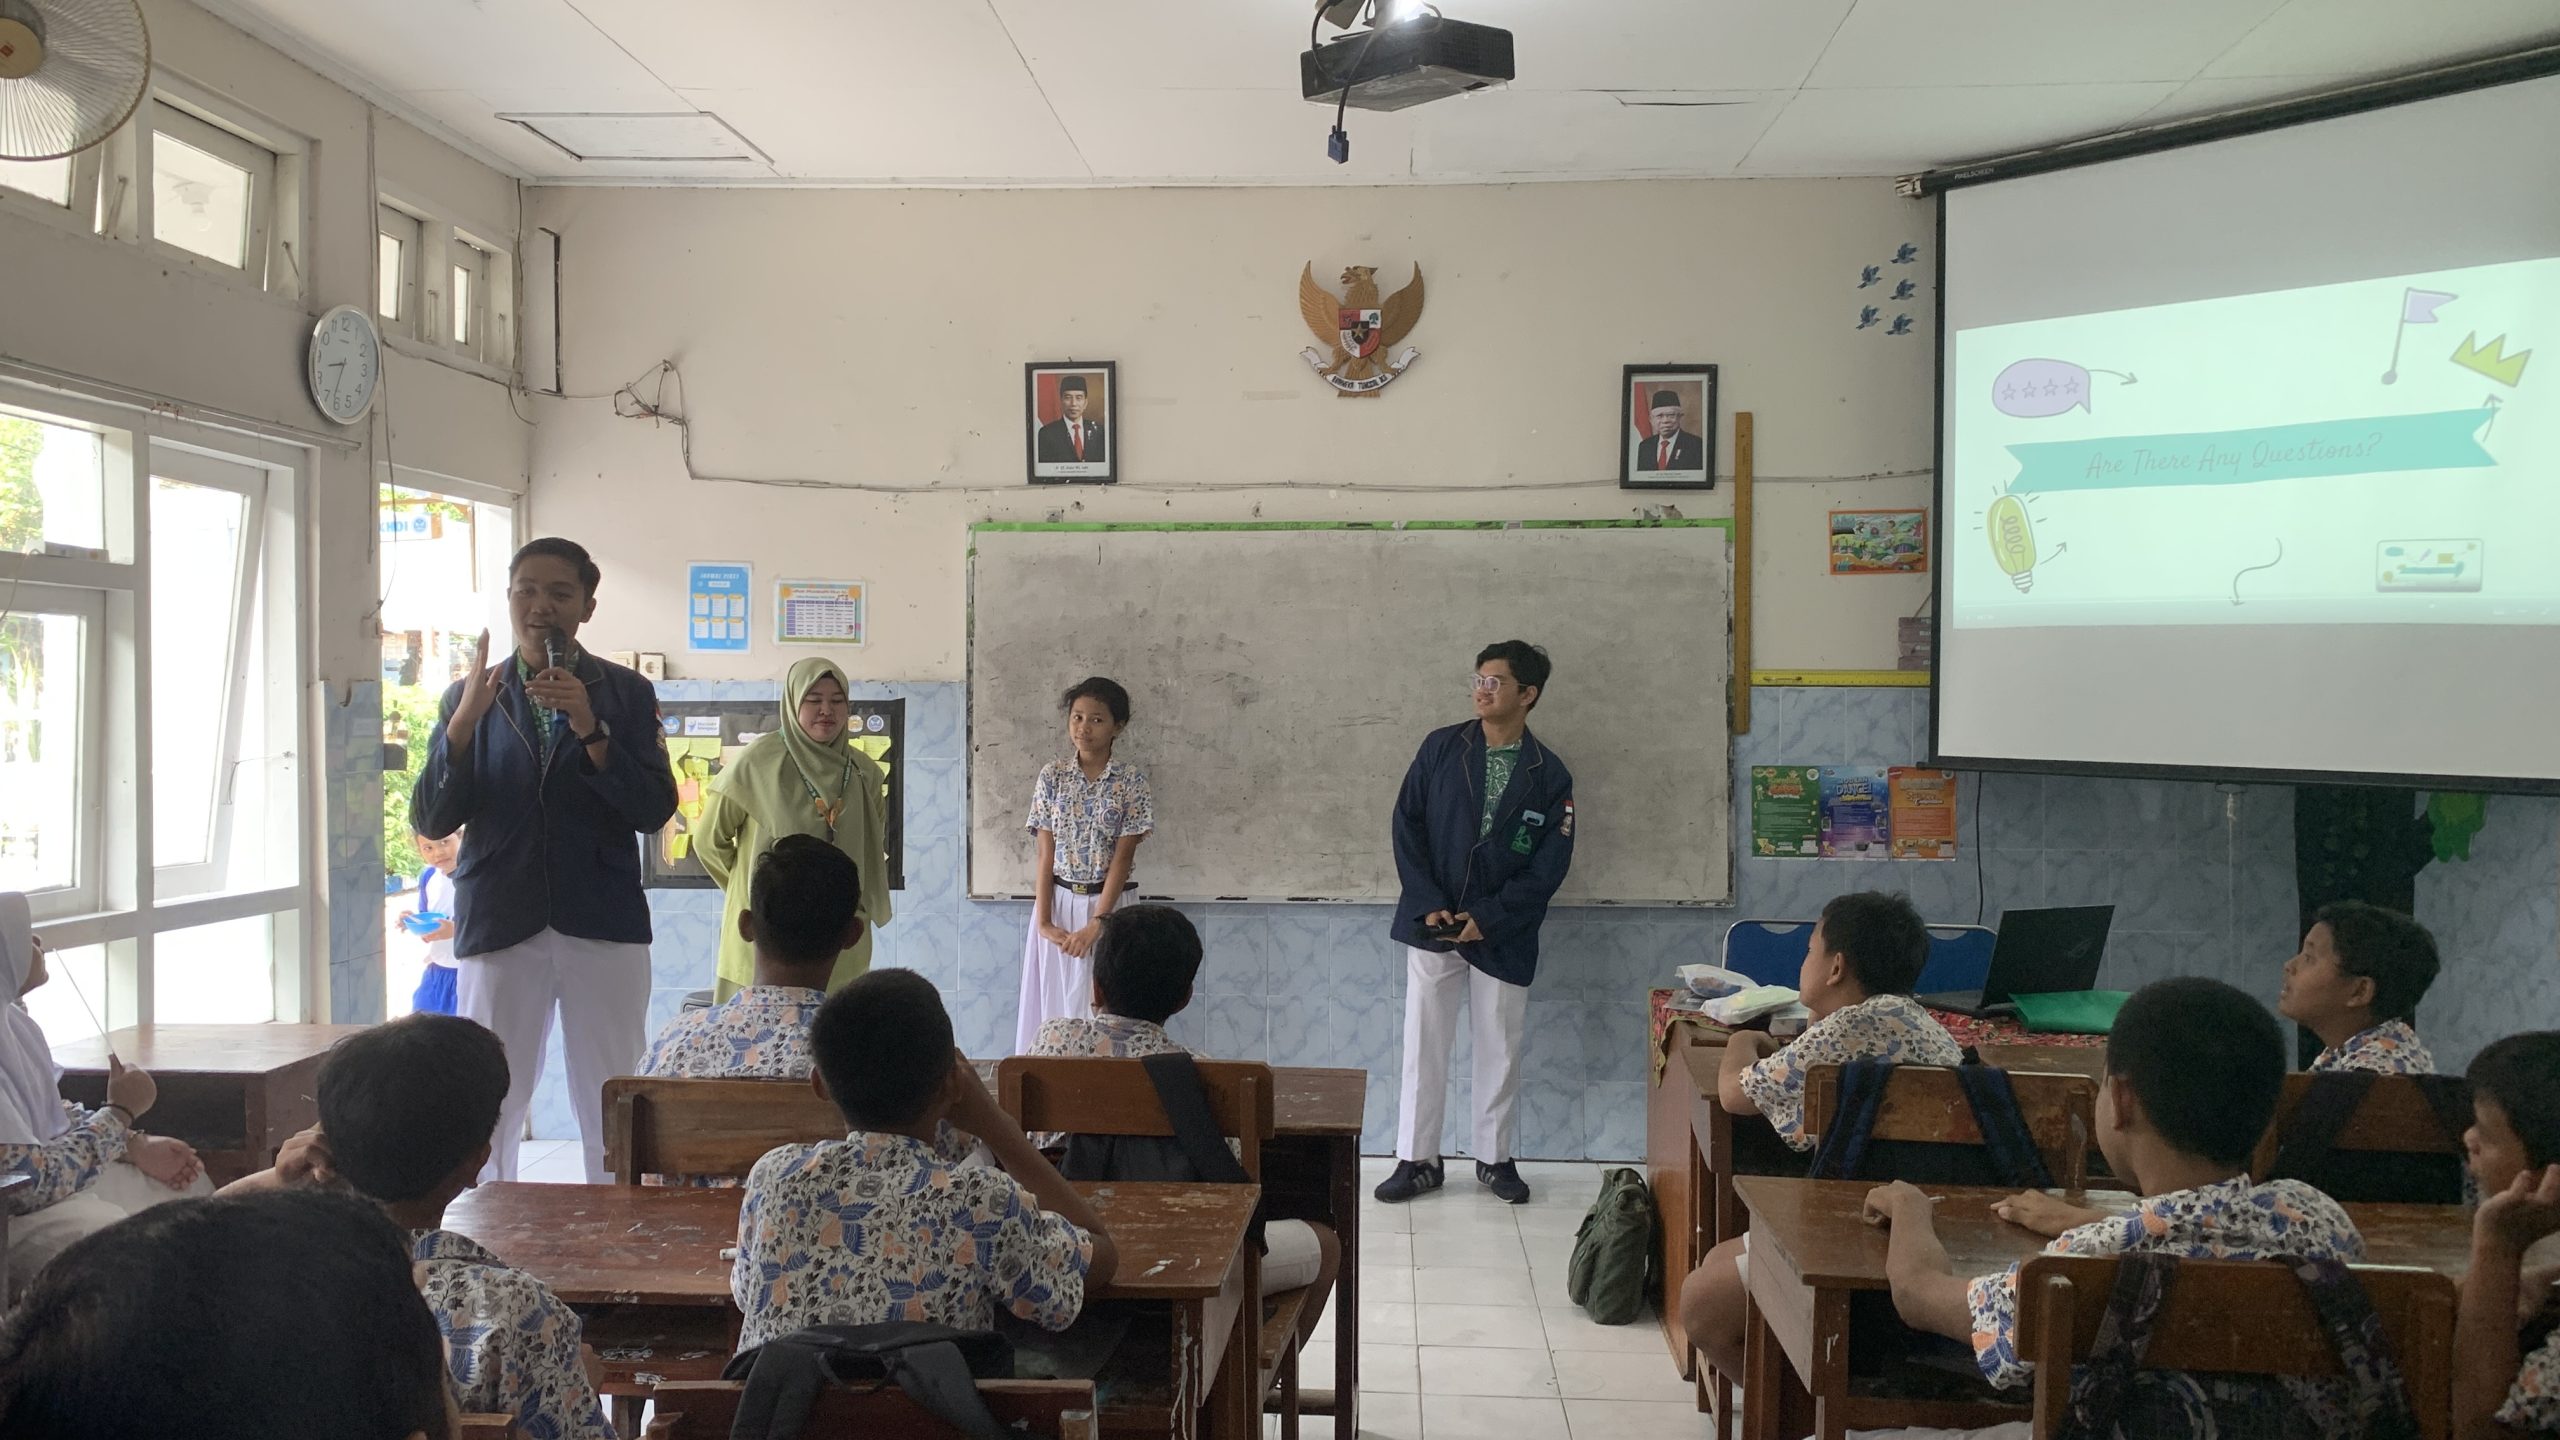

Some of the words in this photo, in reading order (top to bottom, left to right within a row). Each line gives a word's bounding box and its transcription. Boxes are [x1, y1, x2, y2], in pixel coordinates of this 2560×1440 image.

[331, 319, 338, 333] 11
[341, 317, 351, 332] 12
[359, 343, 368, 358] 2
[360, 363, 368, 378] 3
[323, 388, 331, 402] 7
[355, 383, 362, 396] 4
[333, 396, 341, 411] 6
[344, 394, 352, 409] 5
[2085, 451, 2124, 480] Are
[2133, 448, 2191, 476] There
[2198, 443, 2242, 477] Any
[2252, 431, 2383, 469] Questions?
